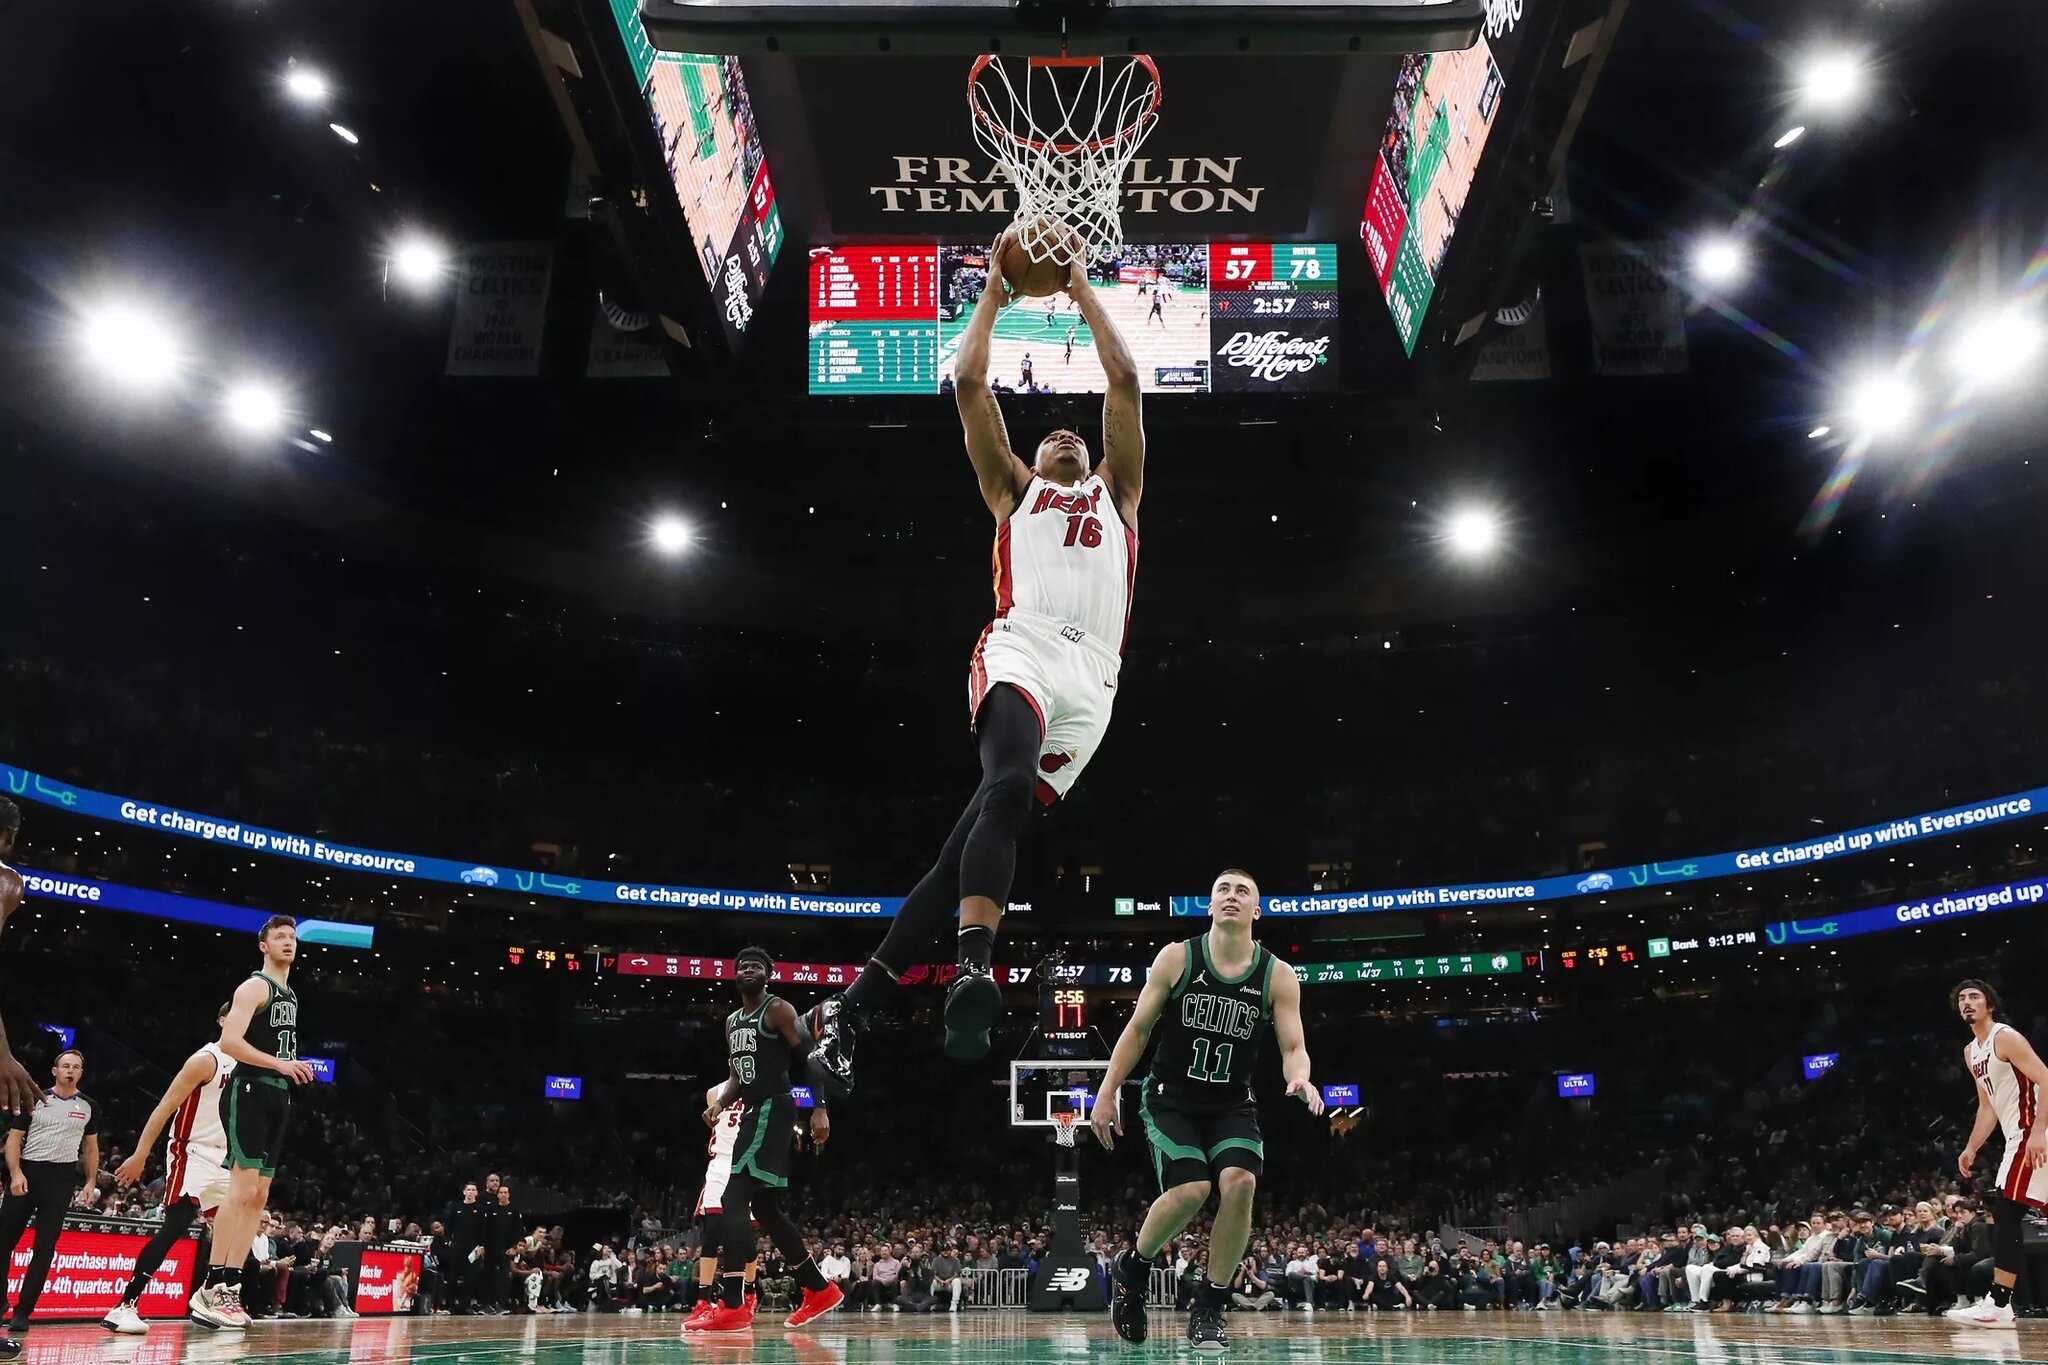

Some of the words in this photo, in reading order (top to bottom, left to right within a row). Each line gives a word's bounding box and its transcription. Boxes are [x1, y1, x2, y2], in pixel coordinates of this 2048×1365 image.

[892, 155, 1242, 184] FRANKLIN
[1225, 260, 1257, 280] 57
[1290, 259, 1321, 279] 78
[469, 276, 542, 295] CELTICS
[1253, 298, 1296, 314] 2:57
[1312, 301, 1330, 310] 3rd
[1217, 331, 1331, 366] Different
[1250, 354, 1317, 382] Here
[1029, 485, 1103, 515] HEAT
[1063, 515, 1103, 548] 16
[120, 801, 158, 824] Get
[160, 811, 240, 839] charged
[243, 830, 267, 849] up
[271, 835, 311, 857] with
[313, 843, 416, 873] Eversource
[1735, 851, 1771, 869] Get
[1772, 835, 1846, 862] charged
[1848, 831, 1873, 850] up
[1875, 820, 1918, 843] with
[1920, 798, 2032, 833] Eversource
[22, 874, 101, 901] rsource
[616, 885, 648, 901] Get
[650, 887, 720, 908] charged
[724, 893, 746, 909] up
[749, 894, 787, 910] with
[790, 896, 881, 914] Eversource
[1008, 902, 1032, 912] Bank
[1117, 902, 1132, 912] TD
[1137, 902, 1161, 912] Bank
[1268, 898, 1299, 913] Get
[1301, 894, 1369, 914] charged
[1372, 892, 1395, 908] up
[1397, 889, 1436, 906] with
[1439, 884, 1535, 903] Eversource
[1896, 904, 1930, 922] Get
[1933, 887, 2012, 913] charged
[2015, 883, 2044, 902] up
[1651, 942, 1667, 955] TD
[1672, 938, 1699, 951] Bank
[1708, 936, 1735, 948] 9:12
[1737, 932, 1756, 944] PM
[509, 954, 520, 964] 78
[536, 950, 556, 961] 2:56
[1525, 956, 1538, 966] 17
[1588, 948, 1609, 958] 2:56
[1622, 952, 1634, 962] 57
[568, 961, 580, 970] 57
[603, 958, 614, 968] 17
[1055, 966, 1086, 977] 2:57
[1562, 959, 1574, 968] 78
[666, 965, 678, 975] 33
[690, 966, 700, 976] 15
[715, 968, 722, 977] 5
[793, 972, 818, 982] 20/65
[827, 974, 843, 983] 30.8
[1008, 968, 1032, 983] 57
[1108, 967, 1132, 983] 78
[1296, 973, 1309, 982] 2.9
[1318, 970, 1344, 980] 27/63
[1356, 968, 1382, 978] 14/37
[1394, 967, 1404, 976] 11
[1418, 966, 1424, 976] 4
[1438, 965, 1450, 974] 19
[1462, 964, 1473, 973] 41
[1054, 990, 1084, 1004] 2:56
[1239, 985, 1262, 996] Amica
[1060, 1004, 1082, 1028] 17
[1182, 993, 1260, 1041] CELTICS
[308, 1063, 328, 1073] LTRA
[1187, 1037, 1233, 1083] 11
[1972, 1052, 1991, 1079] HEAT
[550, 1082, 575, 1090] ULTRA
[1564, 1080, 1588, 1088] ULTRA
[1983, 1076, 1994, 1097] 11
[58, 1252, 108, 1273] purchase
[108, 1252, 136, 1271] when
[157, 1260, 178, 1277] way
[360, 1265, 374, 1278] Miss
[374, 1266, 383, 1278] for
[52, 1276, 72, 1294] 4th
[72, 1278, 114, 1299] quarter.
[150, 1278, 165, 1295] the
[165, 1282, 184, 1300] app.
